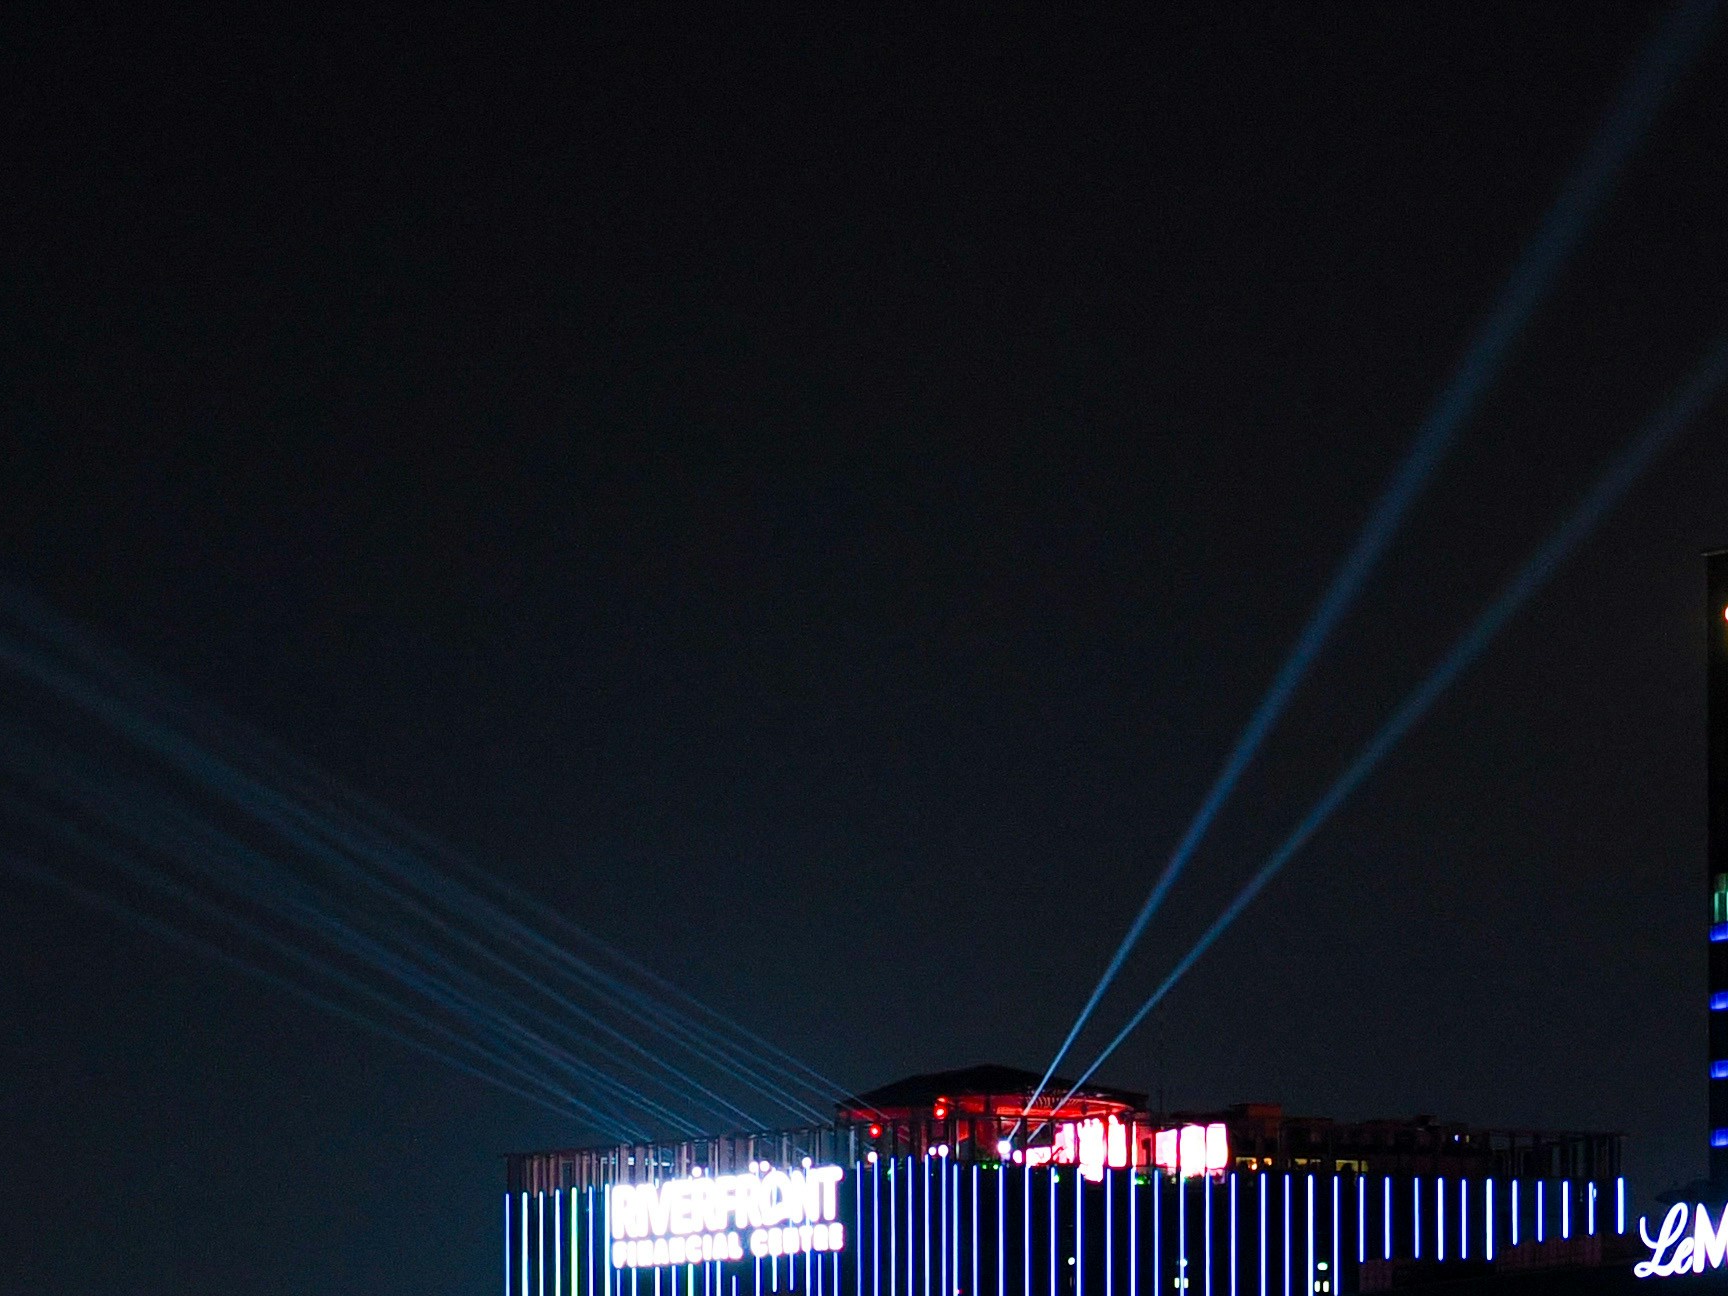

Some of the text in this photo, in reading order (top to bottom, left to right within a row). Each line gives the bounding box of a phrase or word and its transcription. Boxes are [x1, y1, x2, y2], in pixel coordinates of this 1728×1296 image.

[612, 1166, 843, 1240] RIVERFRONT
[613, 1223, 844, 1267] FINANCIAL CENTRE
